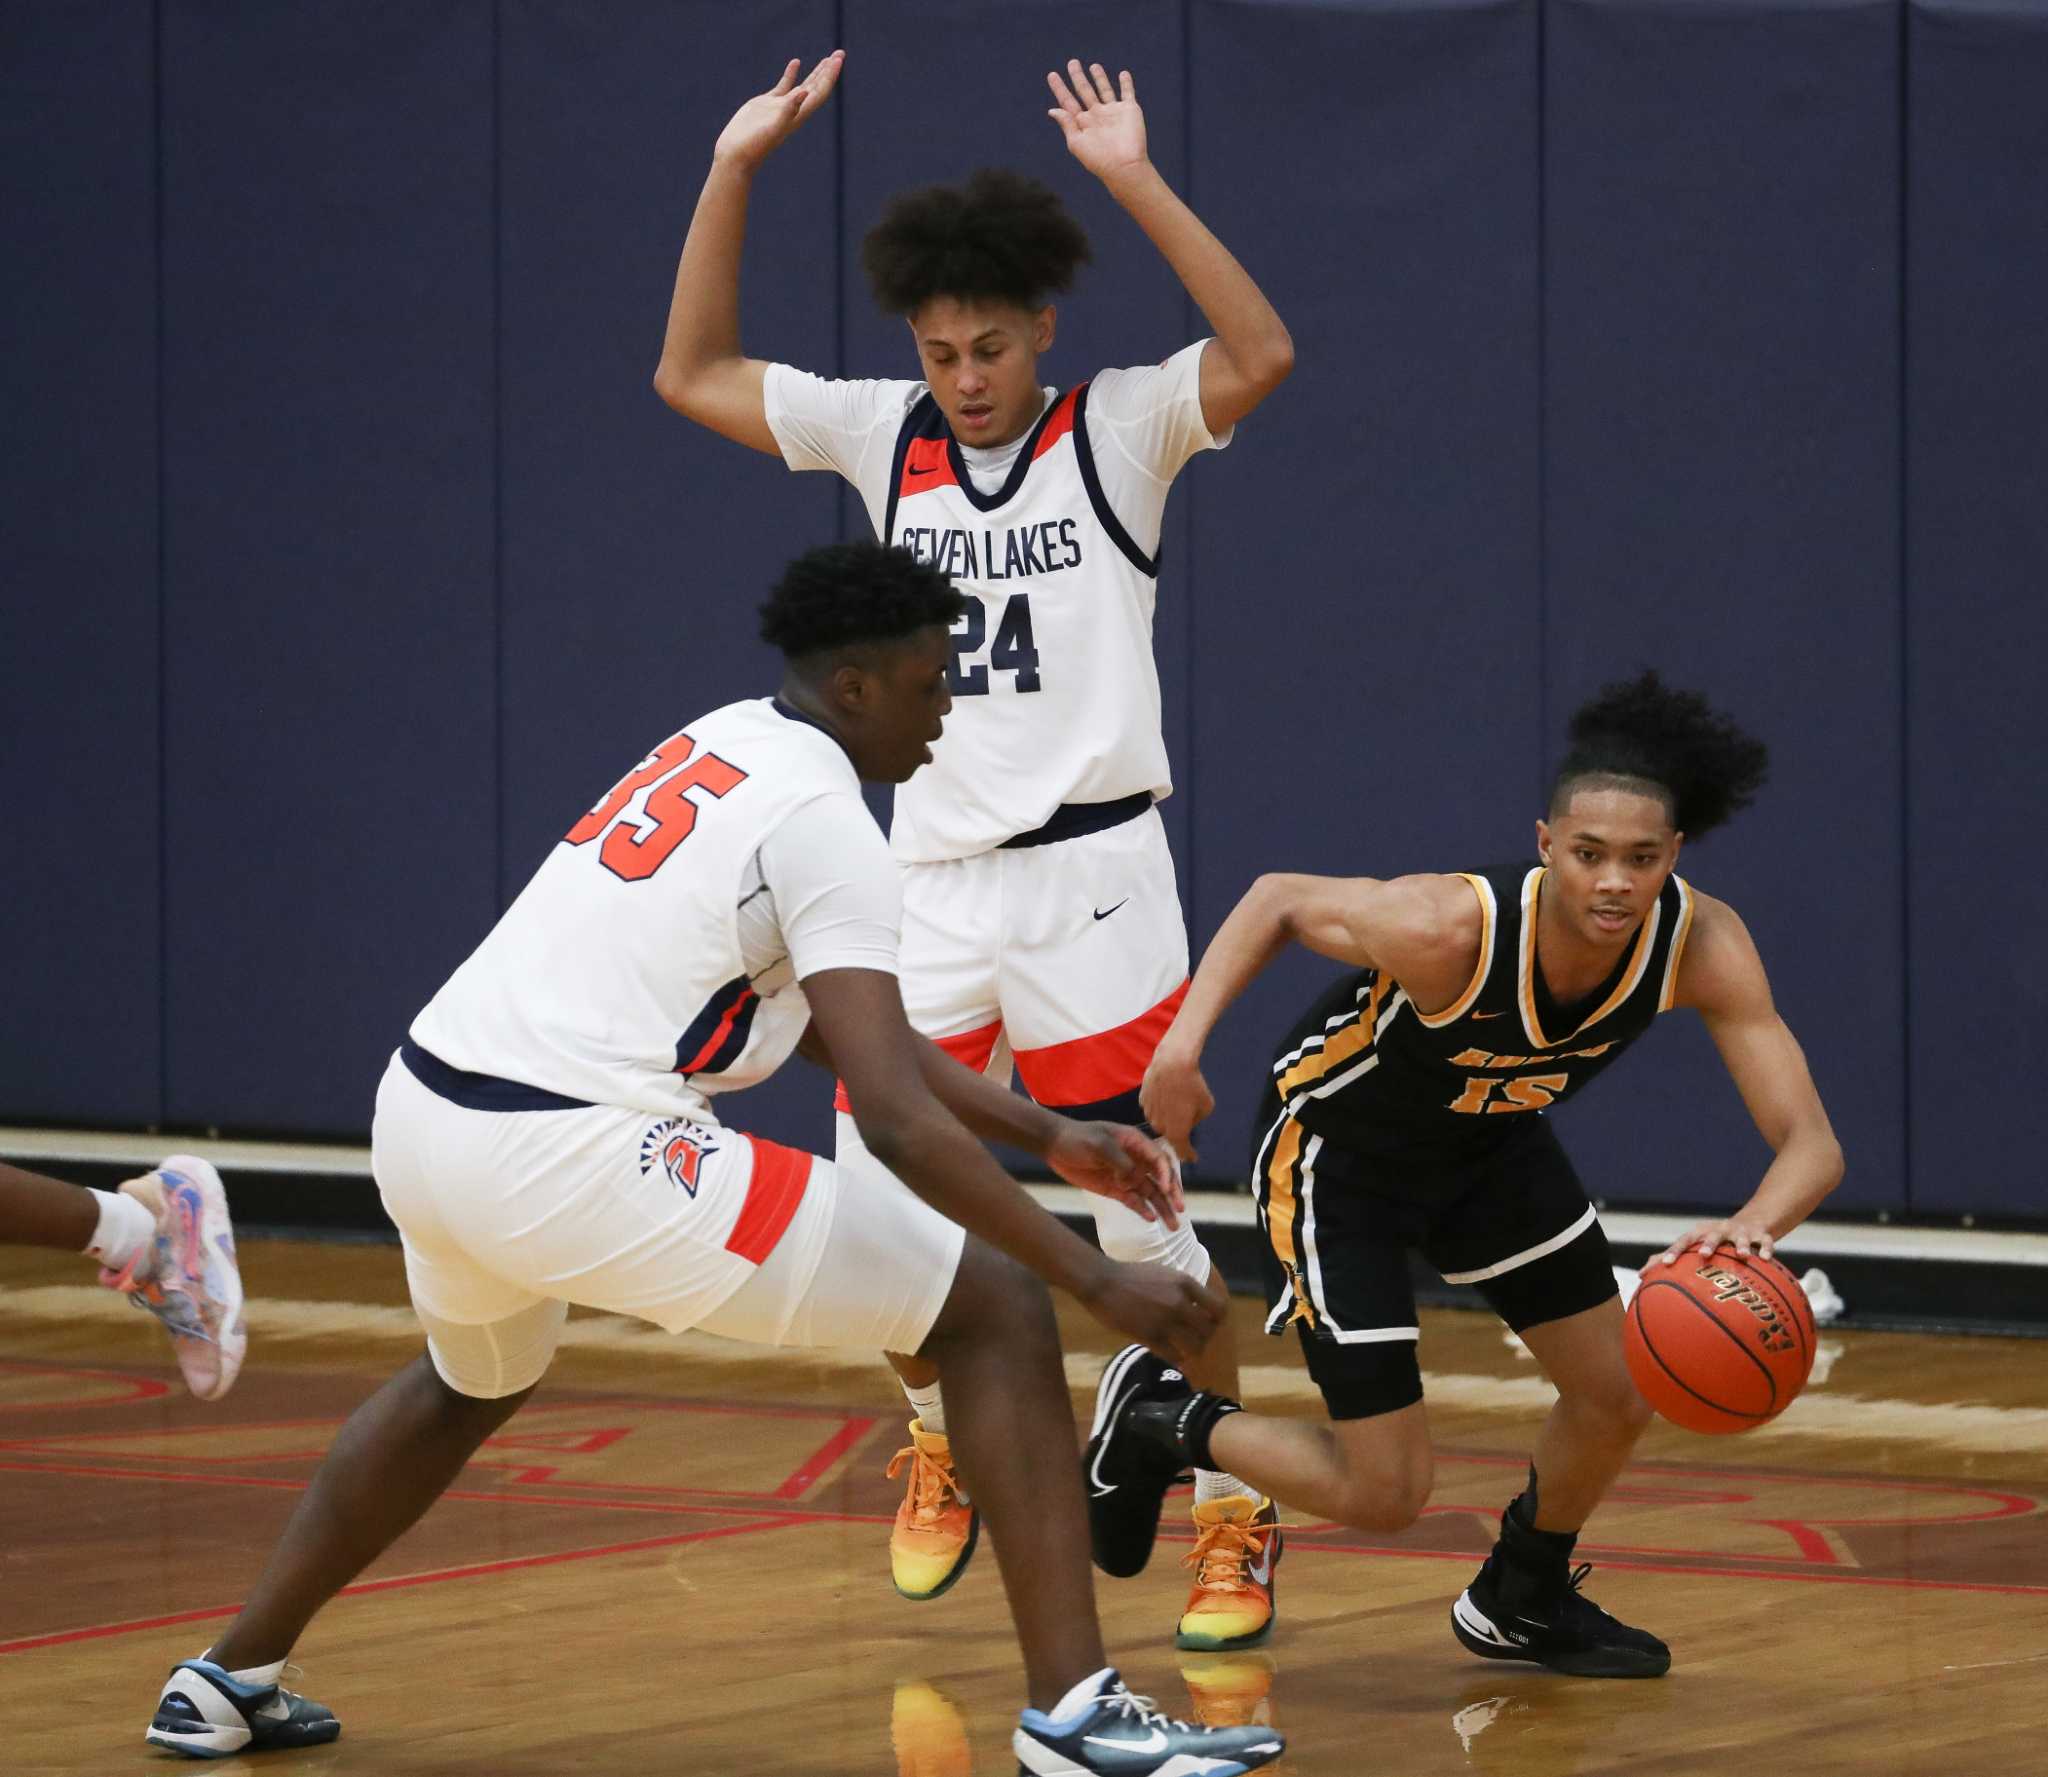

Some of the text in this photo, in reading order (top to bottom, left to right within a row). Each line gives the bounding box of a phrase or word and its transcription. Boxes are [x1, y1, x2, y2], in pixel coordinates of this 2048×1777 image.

[985, 518, 1082, 580] LAKES
[948, 593, 1041, 697] 24
[1446, 1073, 1569, 1114] 15
[1695, 1263, 1796, 1354] Baden
